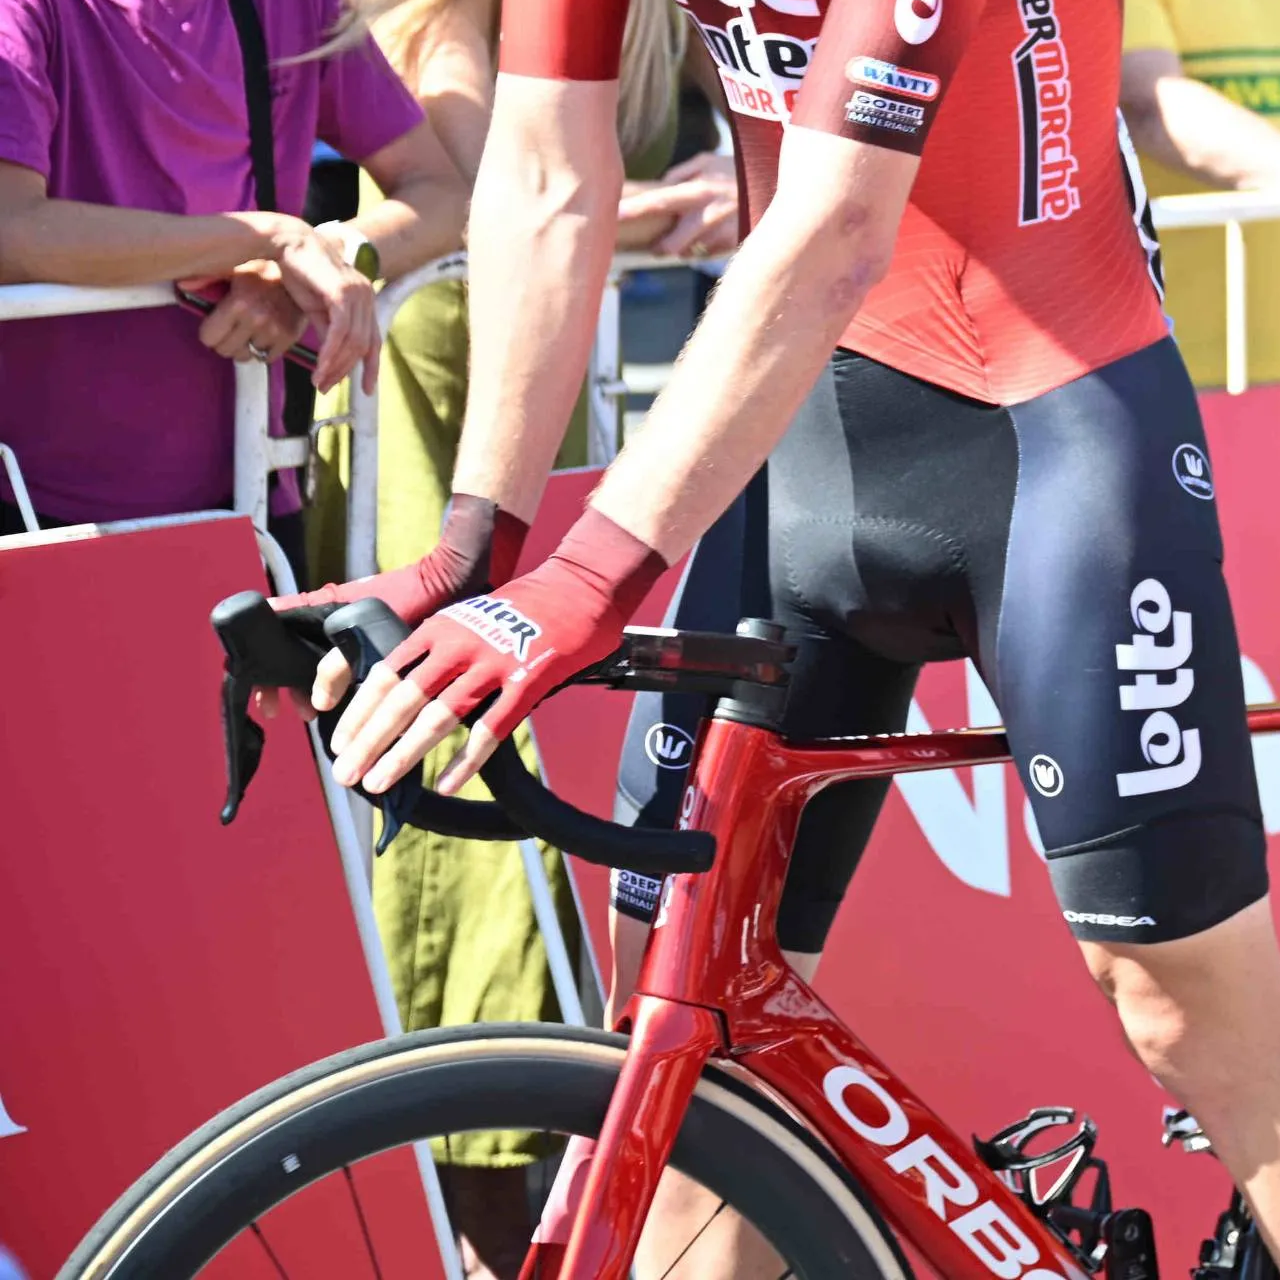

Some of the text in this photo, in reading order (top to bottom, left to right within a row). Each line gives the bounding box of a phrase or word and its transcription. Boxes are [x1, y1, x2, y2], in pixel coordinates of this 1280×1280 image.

[863, 66, 933, 94] WANTY
[856, 95, 922, 118] GOBERT
[1115, 577, 1202, 798] lotto
[1062, 909, 1156, 928] ORBEA
